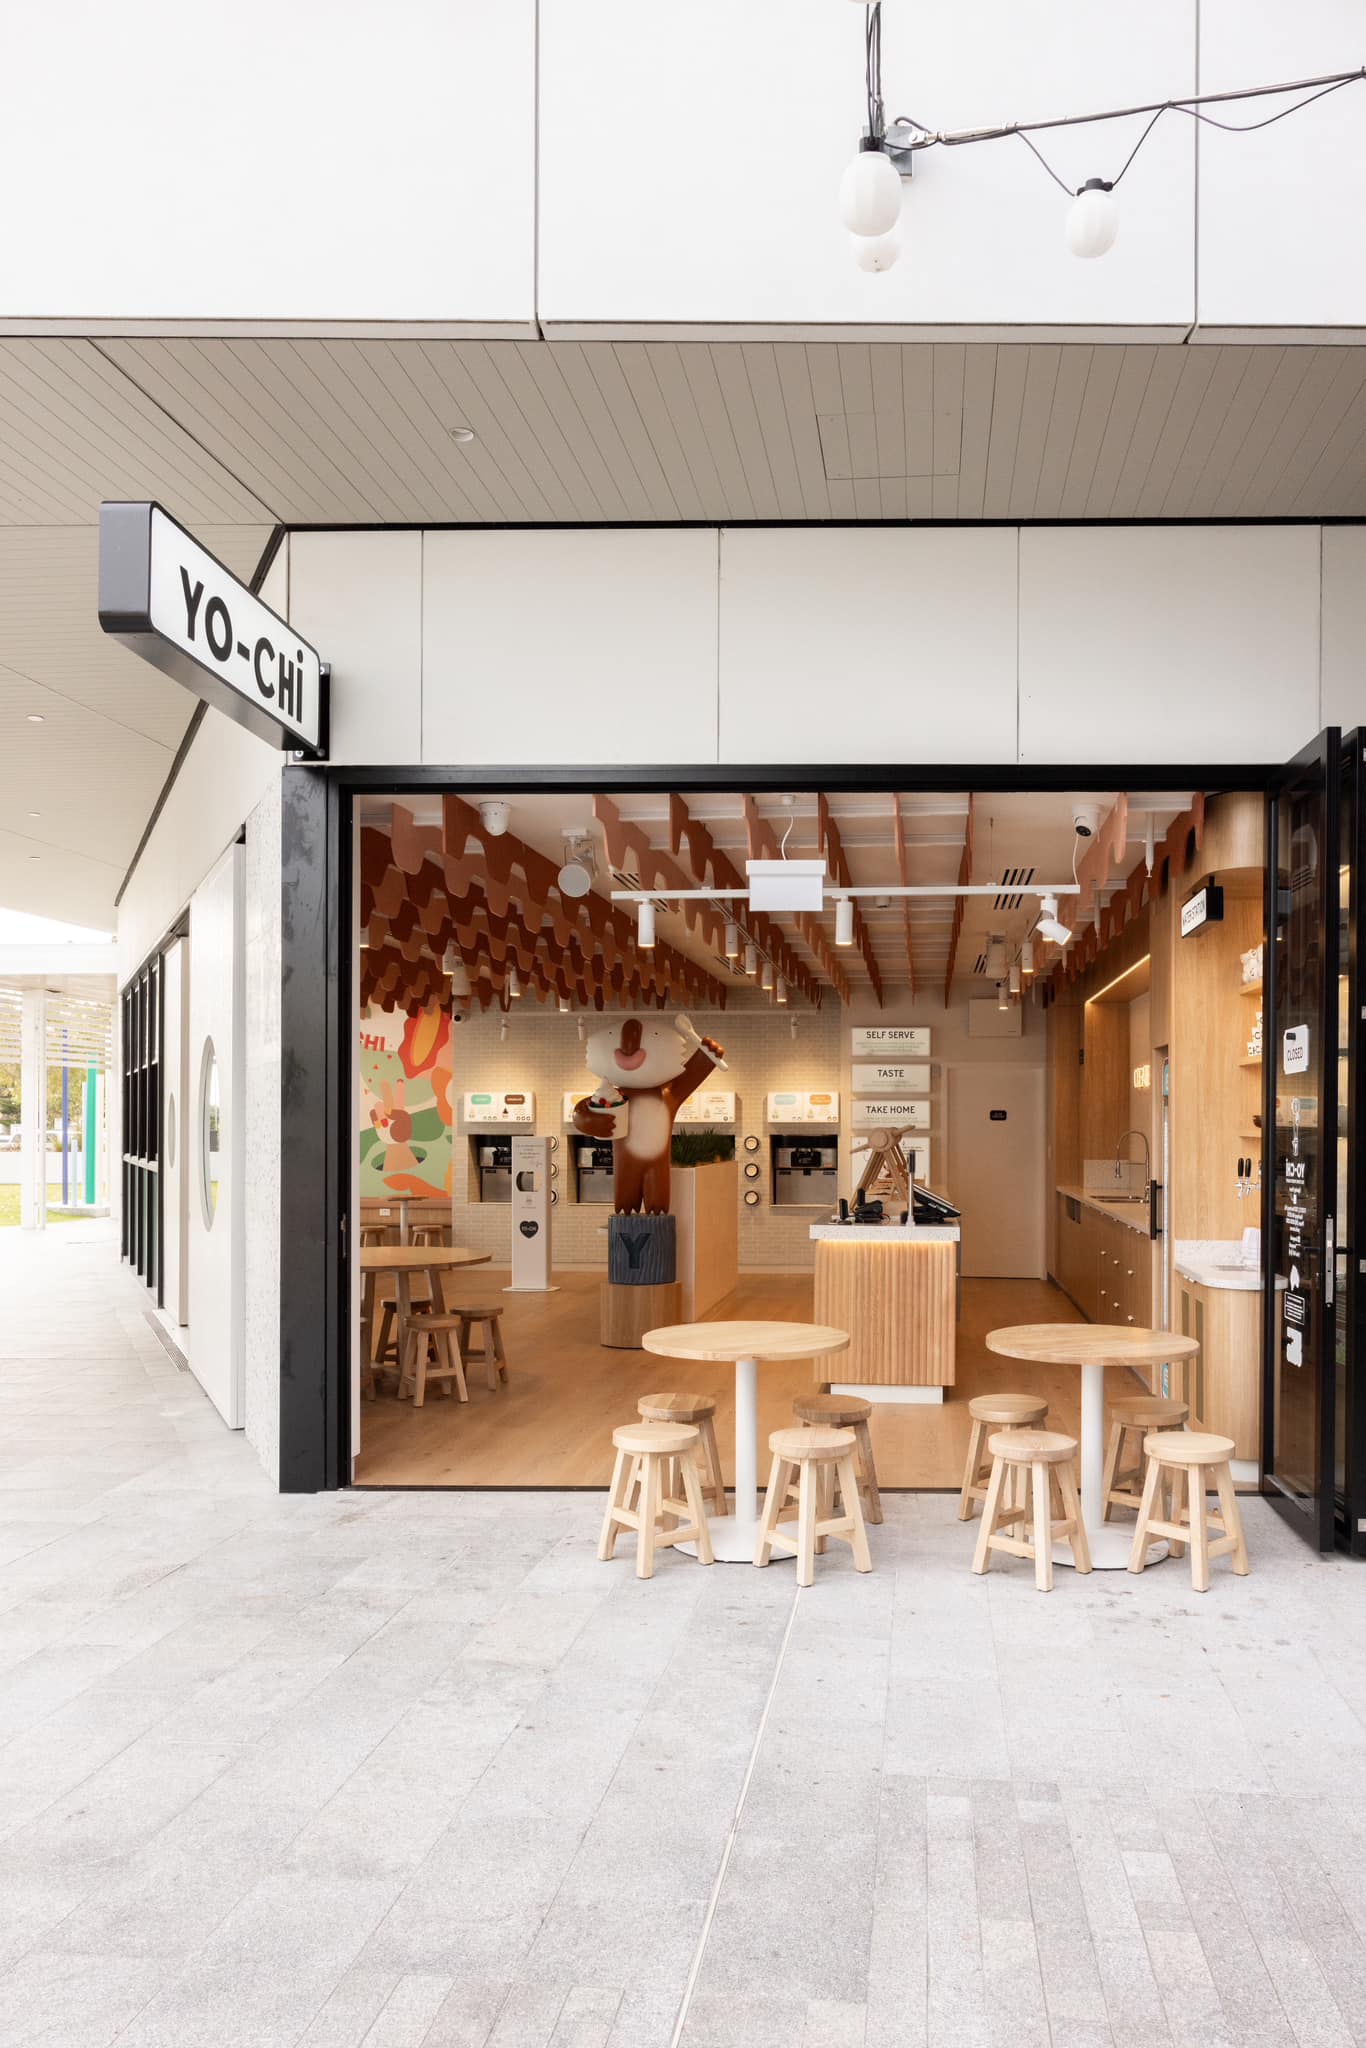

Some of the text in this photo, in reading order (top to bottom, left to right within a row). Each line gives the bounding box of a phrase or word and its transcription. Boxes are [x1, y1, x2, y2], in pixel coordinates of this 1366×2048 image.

[866, 1030, 915, 1039] SELF SERVE
[360, 1031, 386, 1052] HI
[1286, 1046, 1304, 1062] CLOSED
[877, 1069, 905, 1078] TASTE
[866, 1105, 916, 1114] TAKE HOME
[616, 1232, 653, 1270] Y
